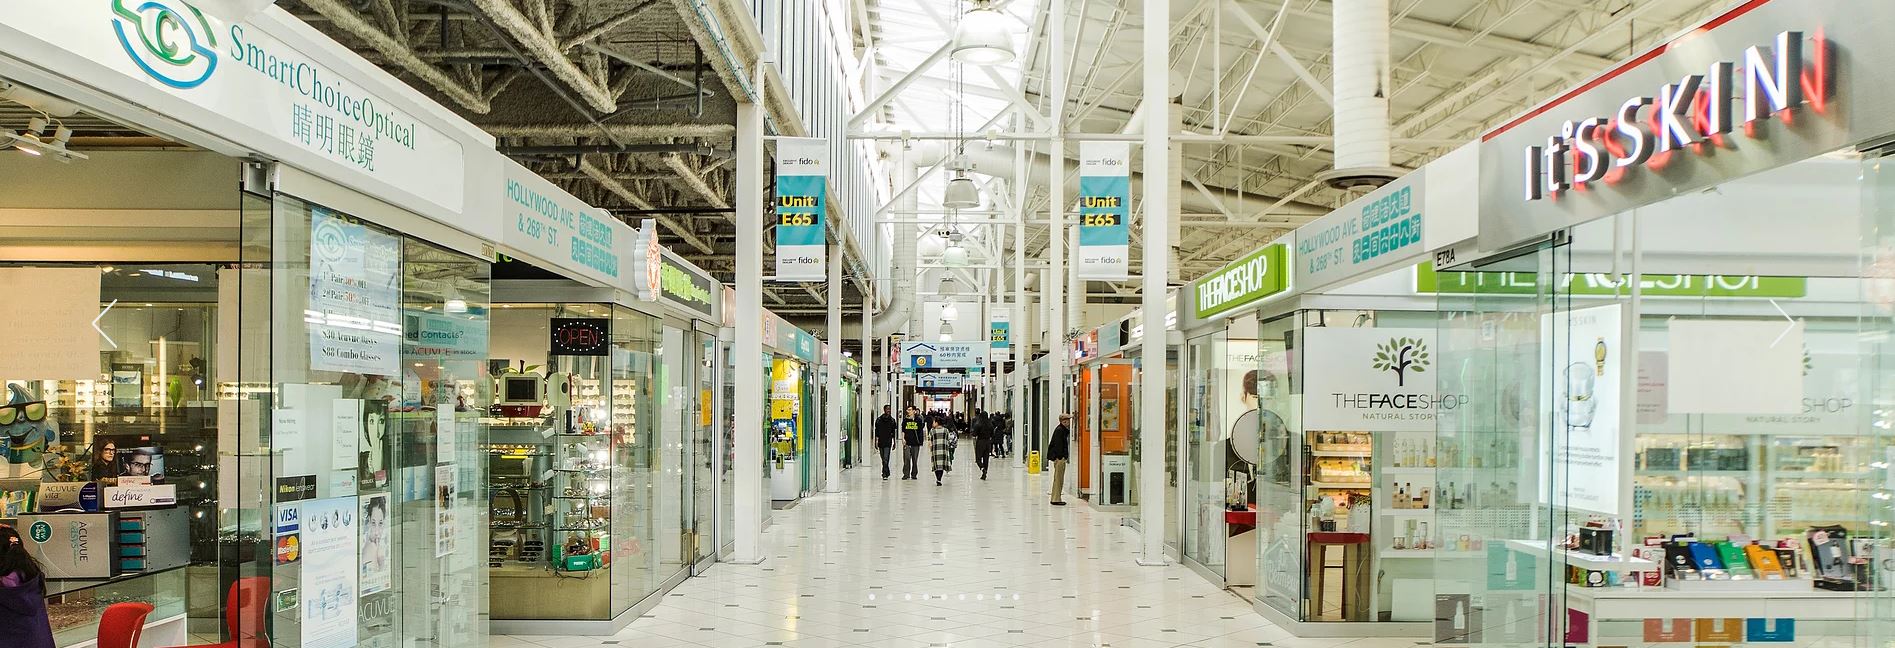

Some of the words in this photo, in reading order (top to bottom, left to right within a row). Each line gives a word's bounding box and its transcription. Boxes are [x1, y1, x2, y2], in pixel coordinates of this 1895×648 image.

[230, 24, 417, 150] SmartChoiceOptical
[799, 157, 813, 165] fido
[1102, 158, 1117, 166] fido
[507, 178, 558, 219] HOLLYWOOD
[560, 207, 575, 231] AVE.
[782, 195, 814, 207] Unit
[1085, 196, 1117, 208] Unit
[782, 212, 812, 227] E65
[1085, 213, 1115, 227] E65
[518, 213, 525, 232] &
[547, 227, 559, 247] ST.
[1300, 224, 1341, 256] HOLLYWOOD
[1342, 217, 1358, 239] AVE.
[798, 256, 813, 264] fido
[1100, 256, 1115, 265] fido
[1309, 263, 1315, 274] &
[1334, 247, 1345, 265] ST.
[1437, 248, 1455, 268] E78A
[331, 273, 343, 284] Pair
[331, 289, 343, 300] Pair
[421, 330, 464, 339] Contacts?
[560, 328, 598, 345] OPEN
[336, 348, 359, 360] Combo
[1331, 392, 1469, 410] THEFACESHOP
[1362, 413, 1406, 421] NATURAL
[1409, 412, 1440, 421] STORY
[1746, 416, 1788, 424] NATURAL
[1791, 416, 1821, 424] STORY
[45, 485, 77, 493] ACUVUE
[279, 484, 296, 494] Nikon
[111, 489, 144, 506] define
[280, 508, 298, 521] VISA
[79, 521, 89, 562] ACUVUE
[358, 596, 396, 622] ACUVUE
